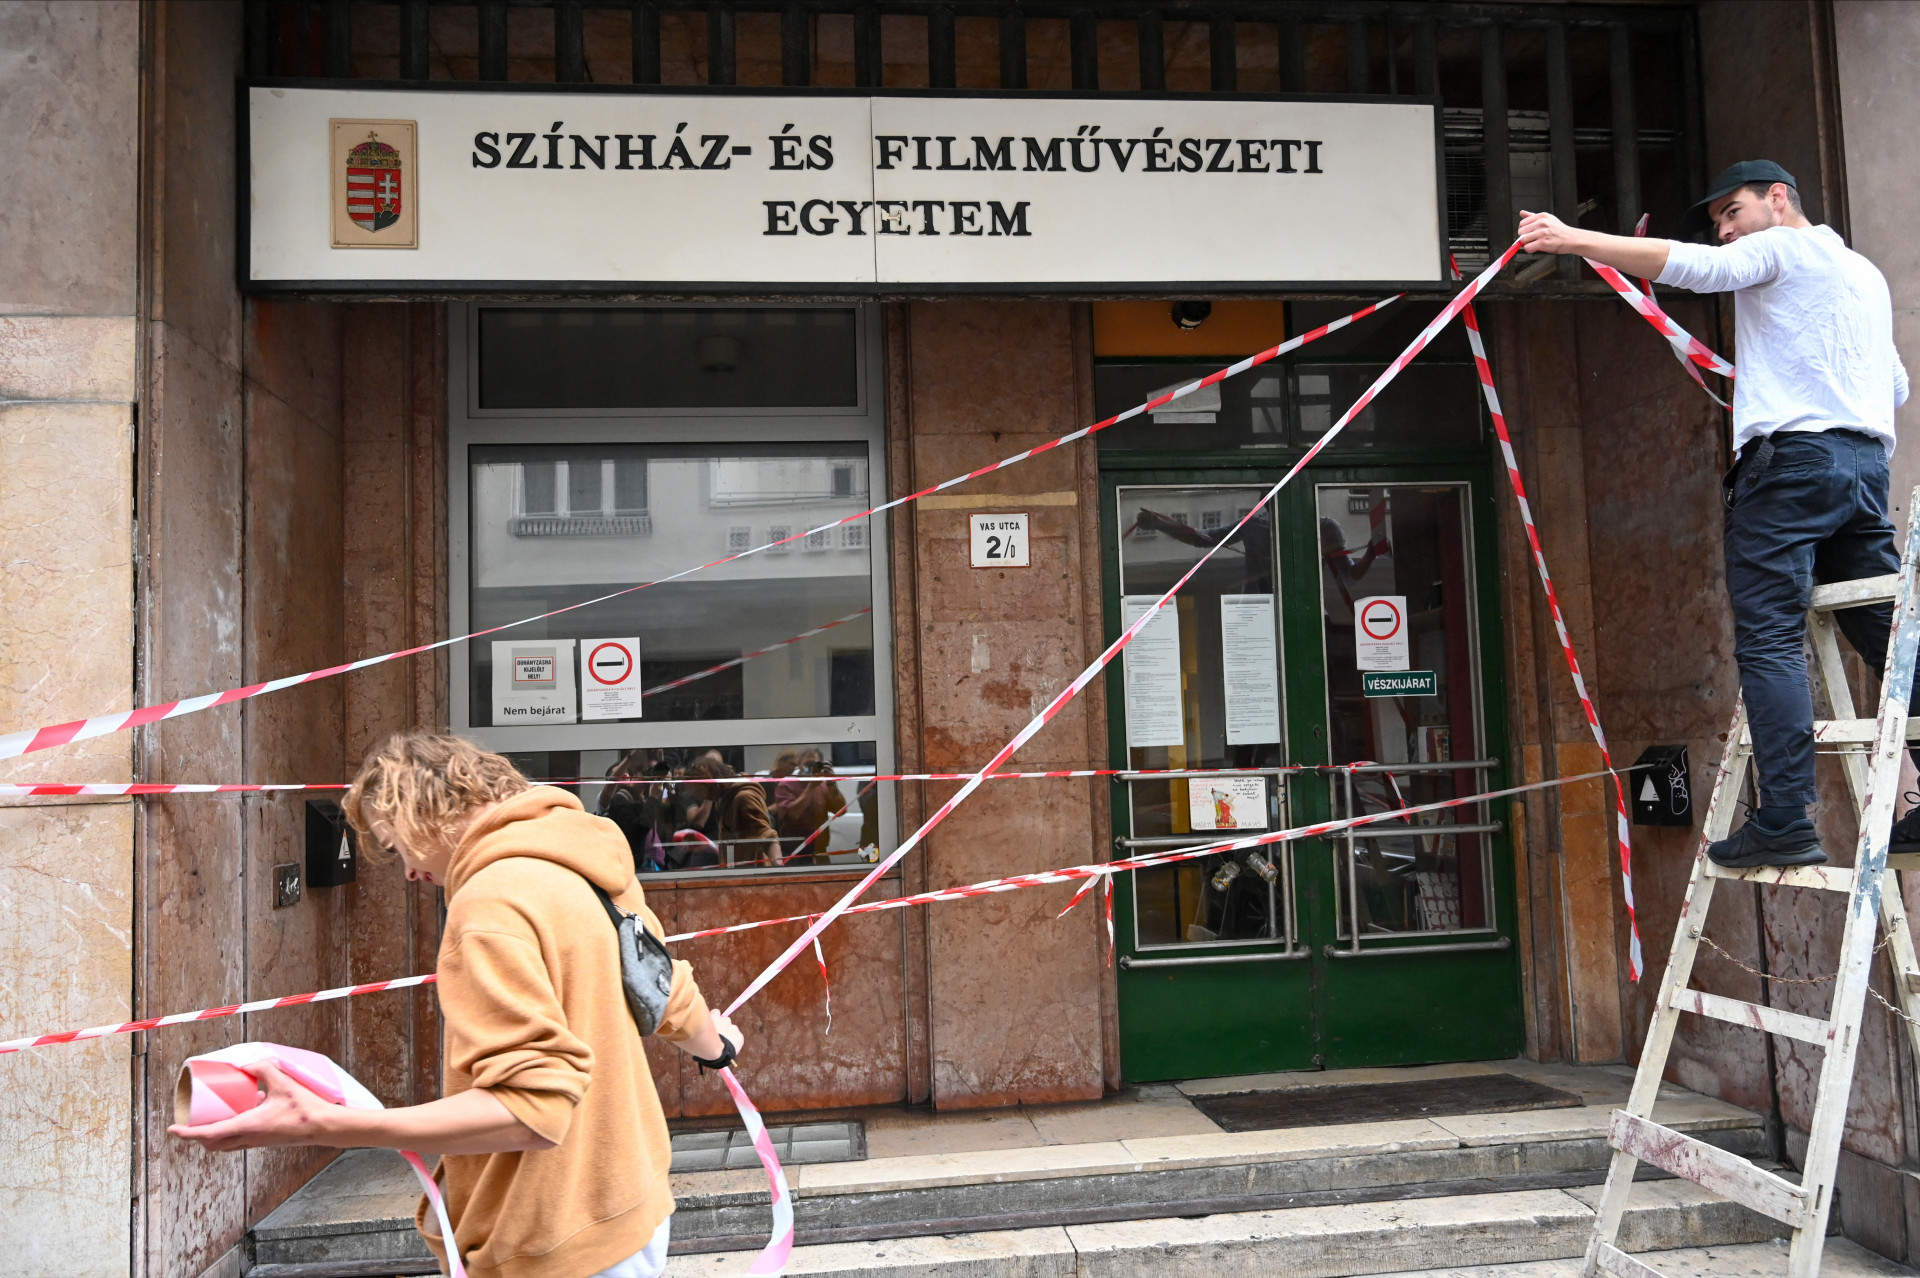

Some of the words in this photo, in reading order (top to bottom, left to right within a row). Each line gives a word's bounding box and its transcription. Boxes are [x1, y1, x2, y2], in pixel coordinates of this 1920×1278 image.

[472, 120, 752, 171] SZÍNHÁZ-
[768, 123, 834, 171] ÉS
[875, 125, 1324, 174] FILMMŰVÉSZETI
[762, 199, 1032, 237] EGYETEM
[980, 522, 995, 531] VAS
[999, 521, 1020, 530] UTCA
[1367, 676, 1431, 691] VÉSZKIJÁRAT
[503, 706, 527, 716] Nem
[530, 706, 566, 717] bejárat
